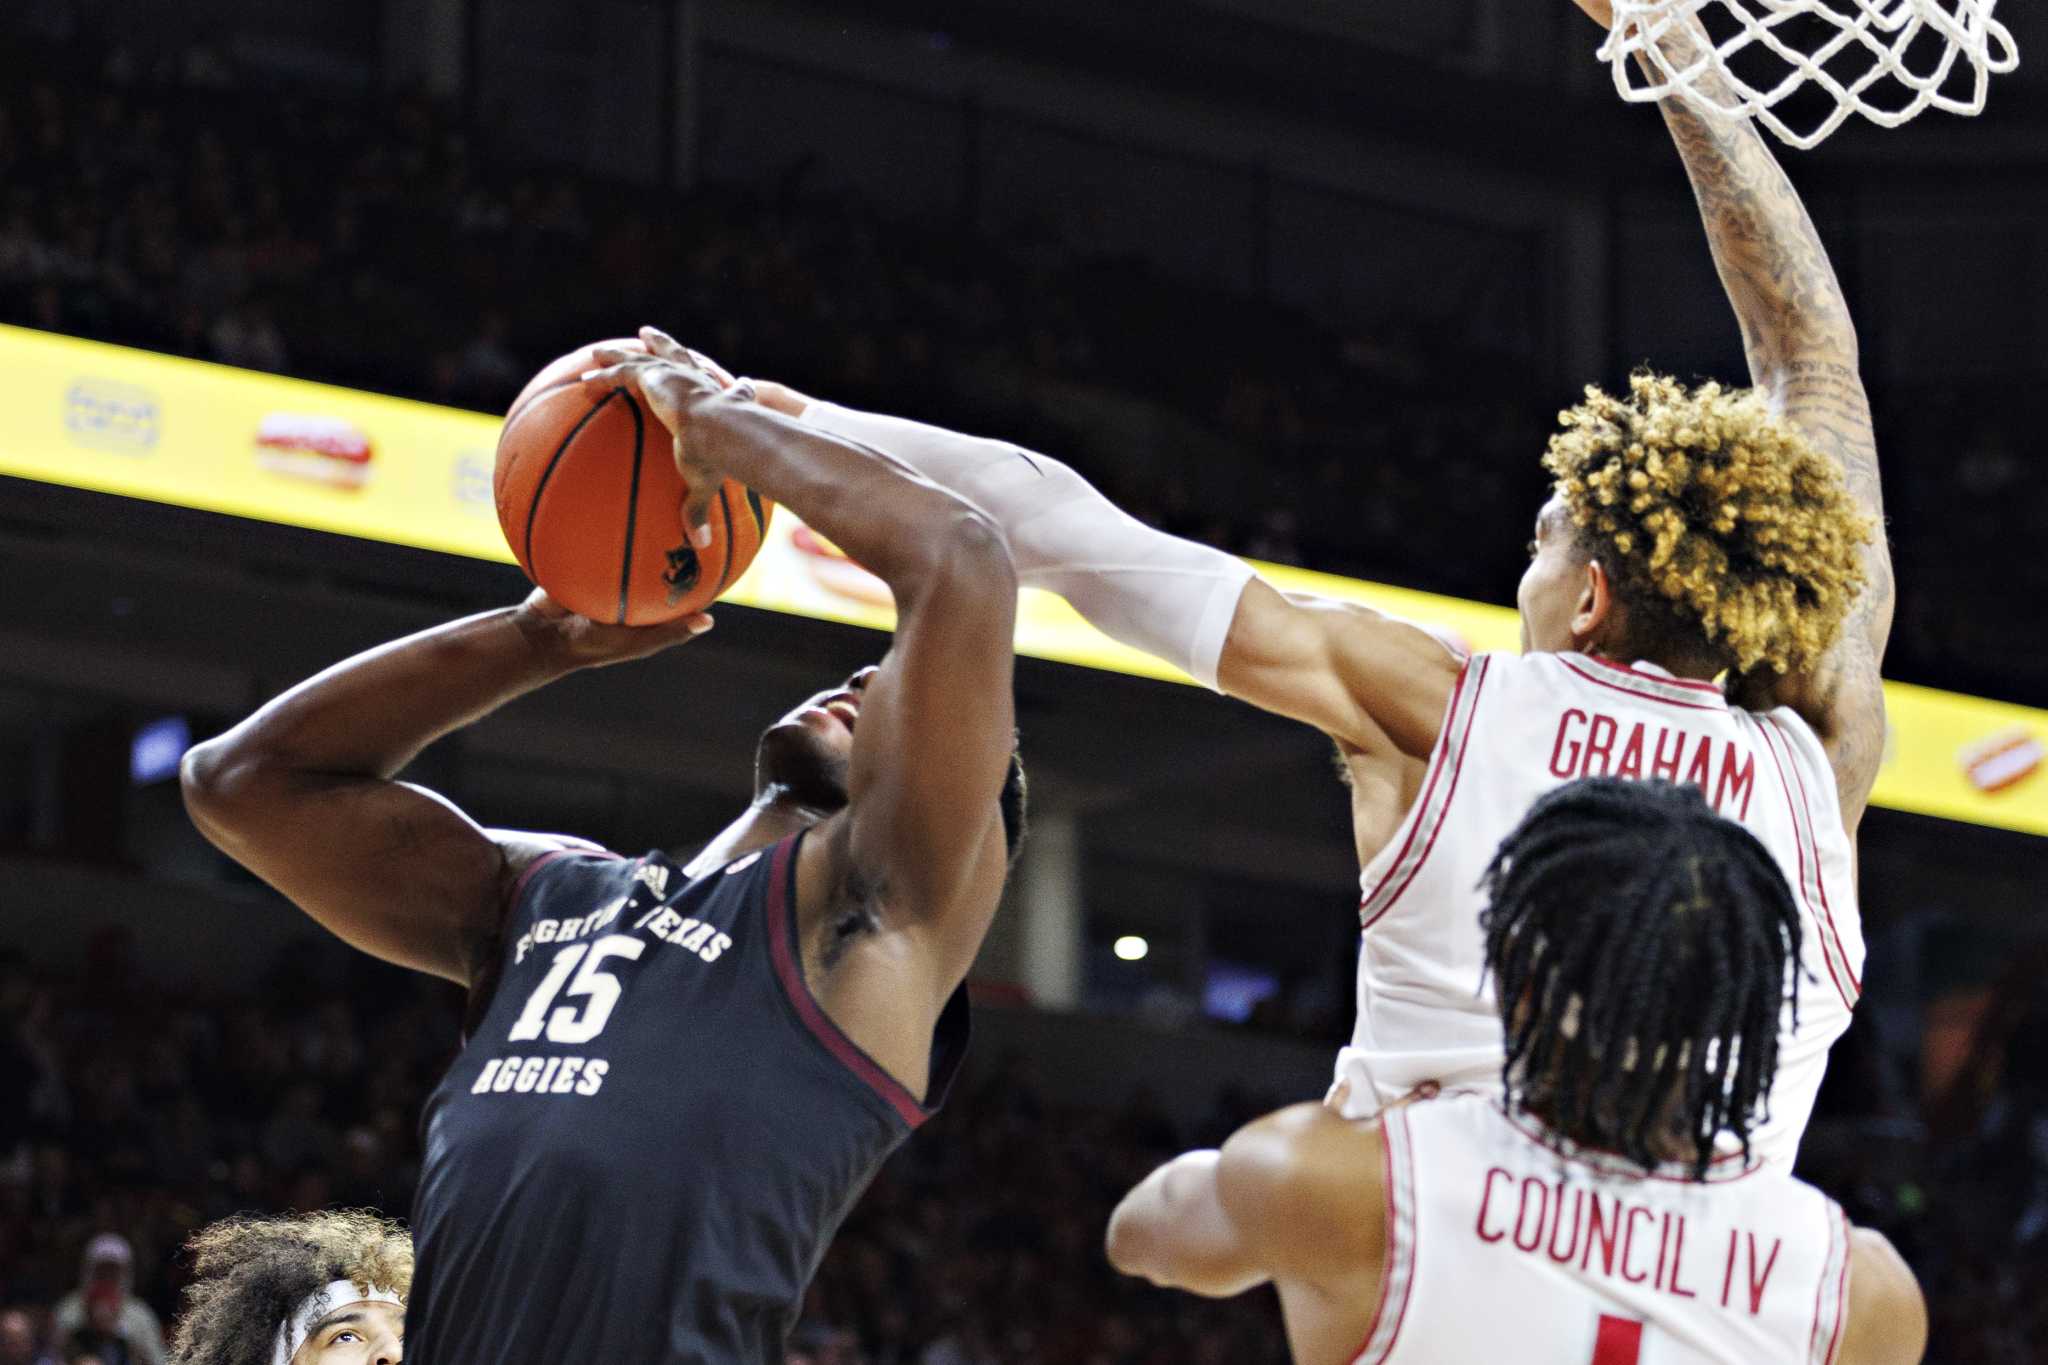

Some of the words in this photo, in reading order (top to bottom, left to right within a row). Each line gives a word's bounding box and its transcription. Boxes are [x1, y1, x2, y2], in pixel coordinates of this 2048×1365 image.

[1549, 708, 1755, 821] GRAHAM
[507, 934, 646, 1044] 15
[470, 1056, 609, 1096] AGGIES
[1475, 1167, 1696, 1298] COUNCIL
[1721, 1228, 1781, 1315] IV
